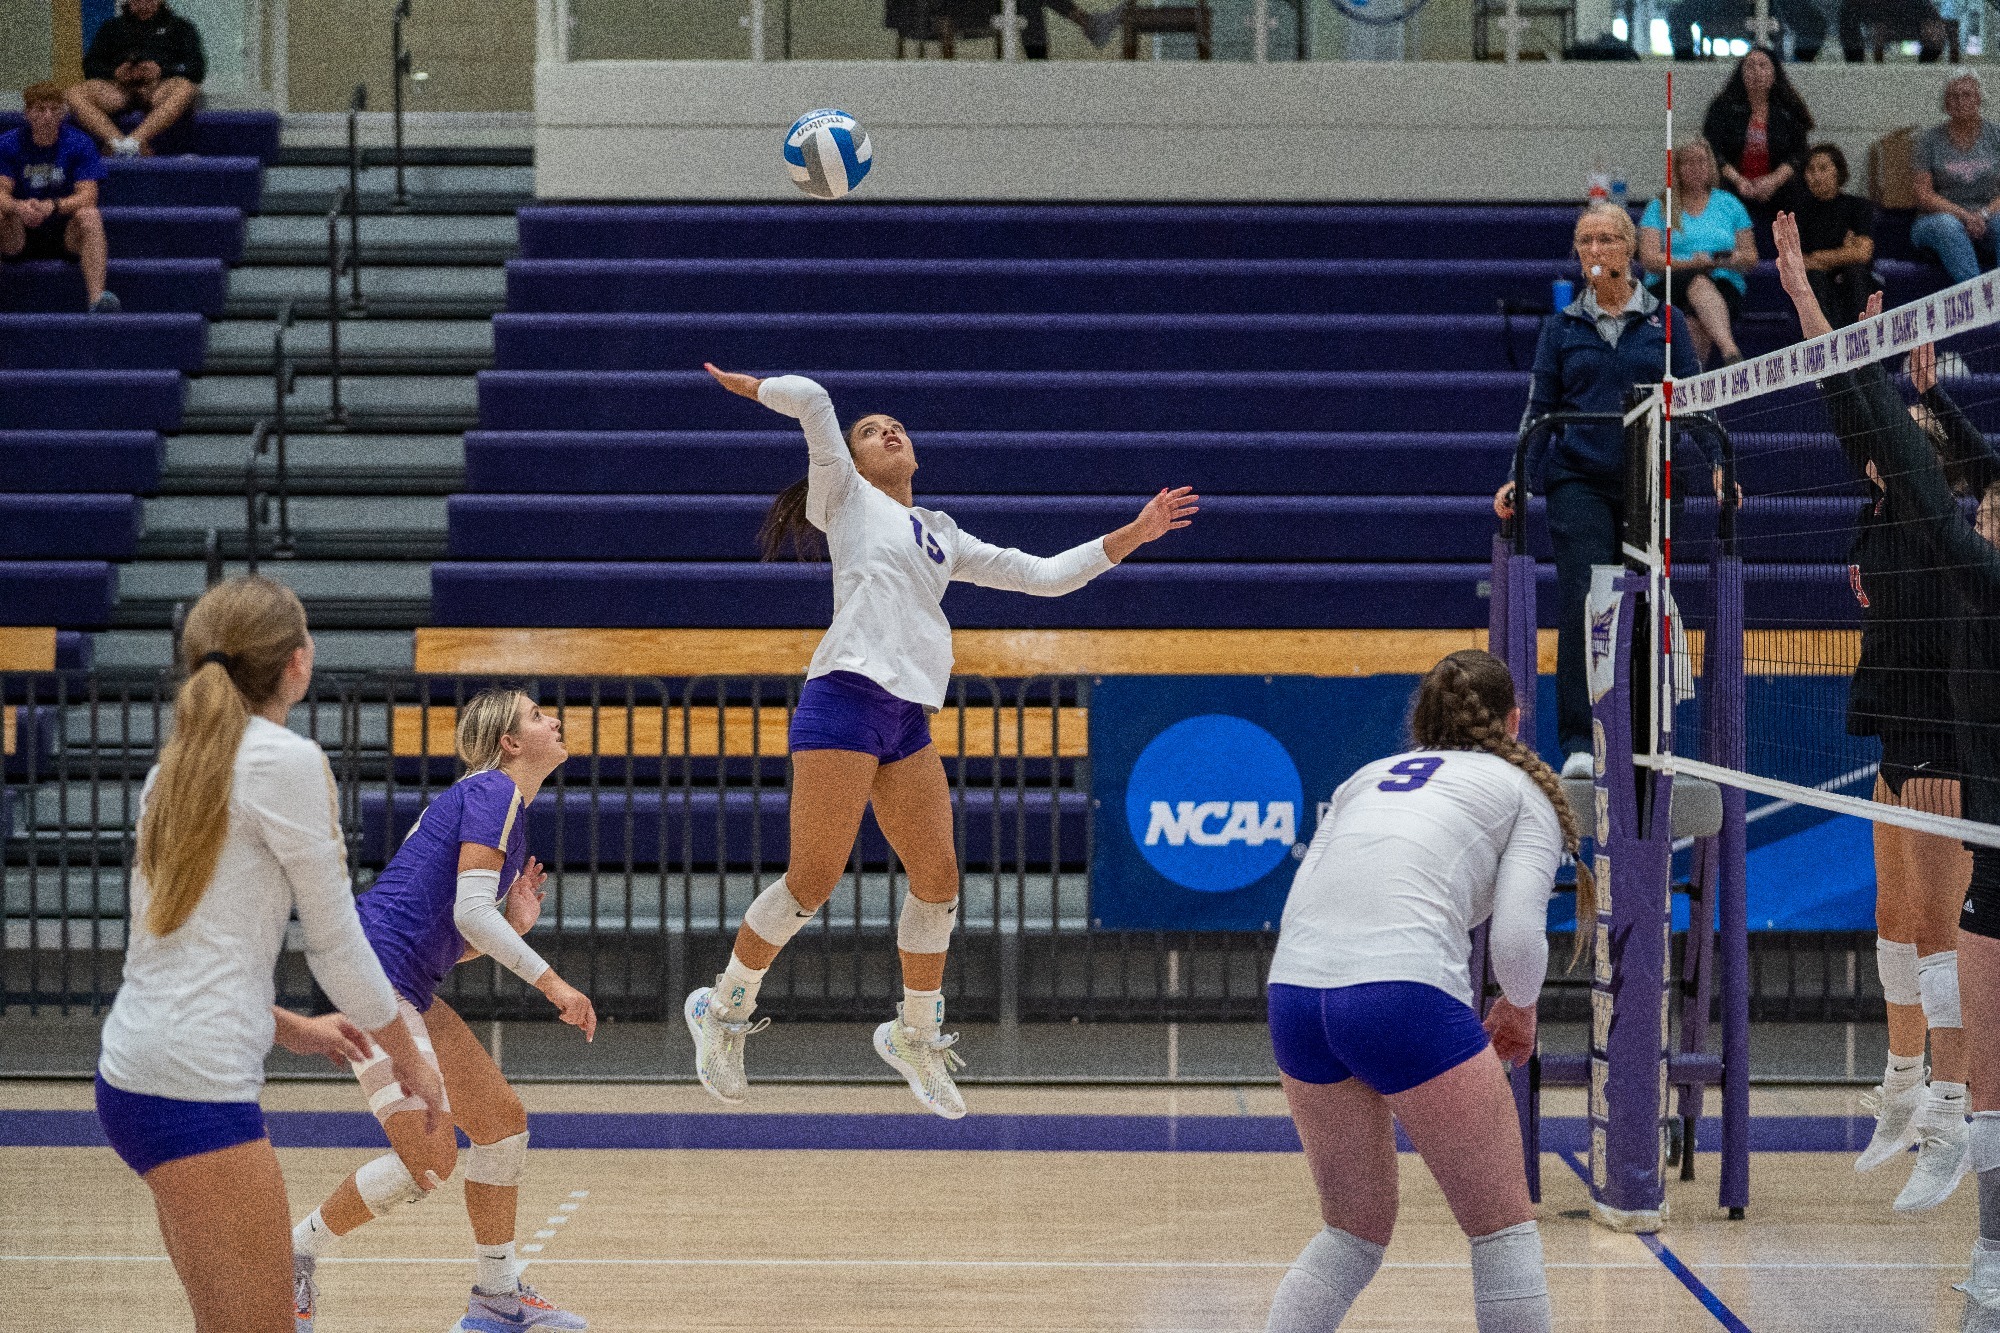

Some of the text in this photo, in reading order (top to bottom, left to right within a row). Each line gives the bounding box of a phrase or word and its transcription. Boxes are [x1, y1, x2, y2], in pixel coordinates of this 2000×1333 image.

[796, 116, 845, 138] molten
[1378, 757, 1445, 791] 9
[1144, 801, 1297, 846] NCAA
